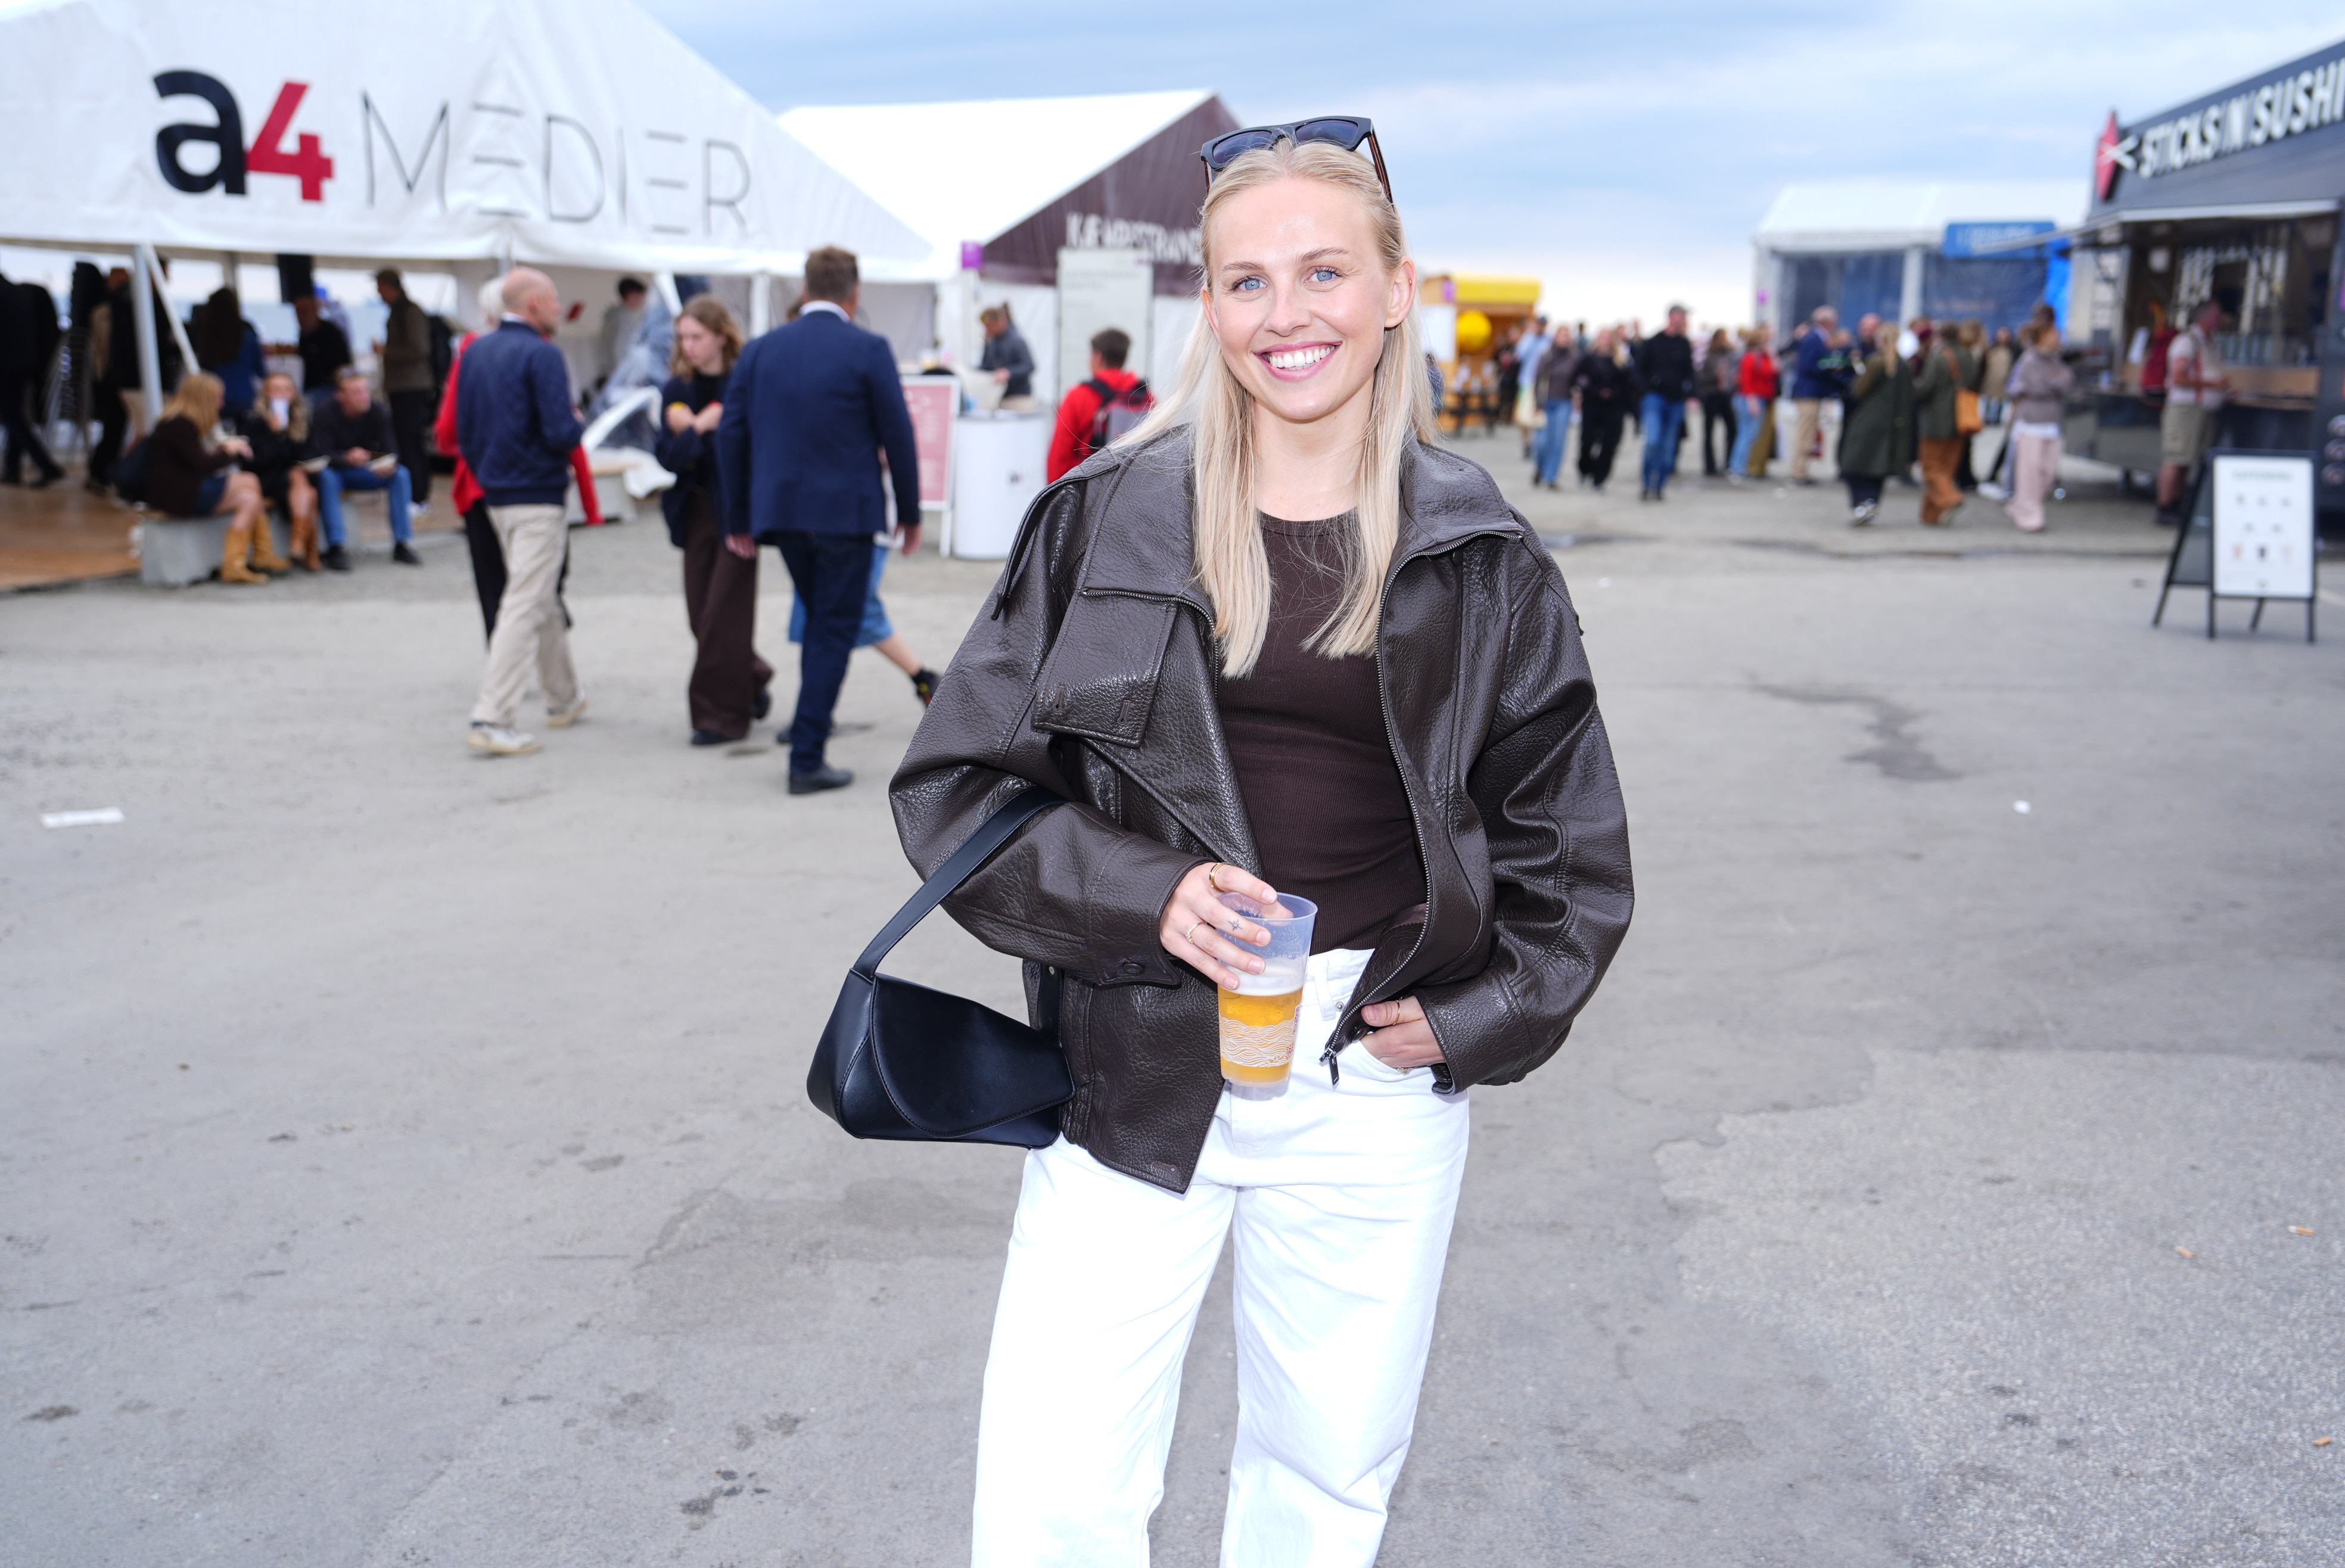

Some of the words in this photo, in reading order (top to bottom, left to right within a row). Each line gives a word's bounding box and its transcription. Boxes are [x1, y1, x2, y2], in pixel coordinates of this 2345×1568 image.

[153, 69, 334, 201] a4
[360, 89, 751, 237] MEDIER
[2250, 57, 2345, 148] SUSHI
